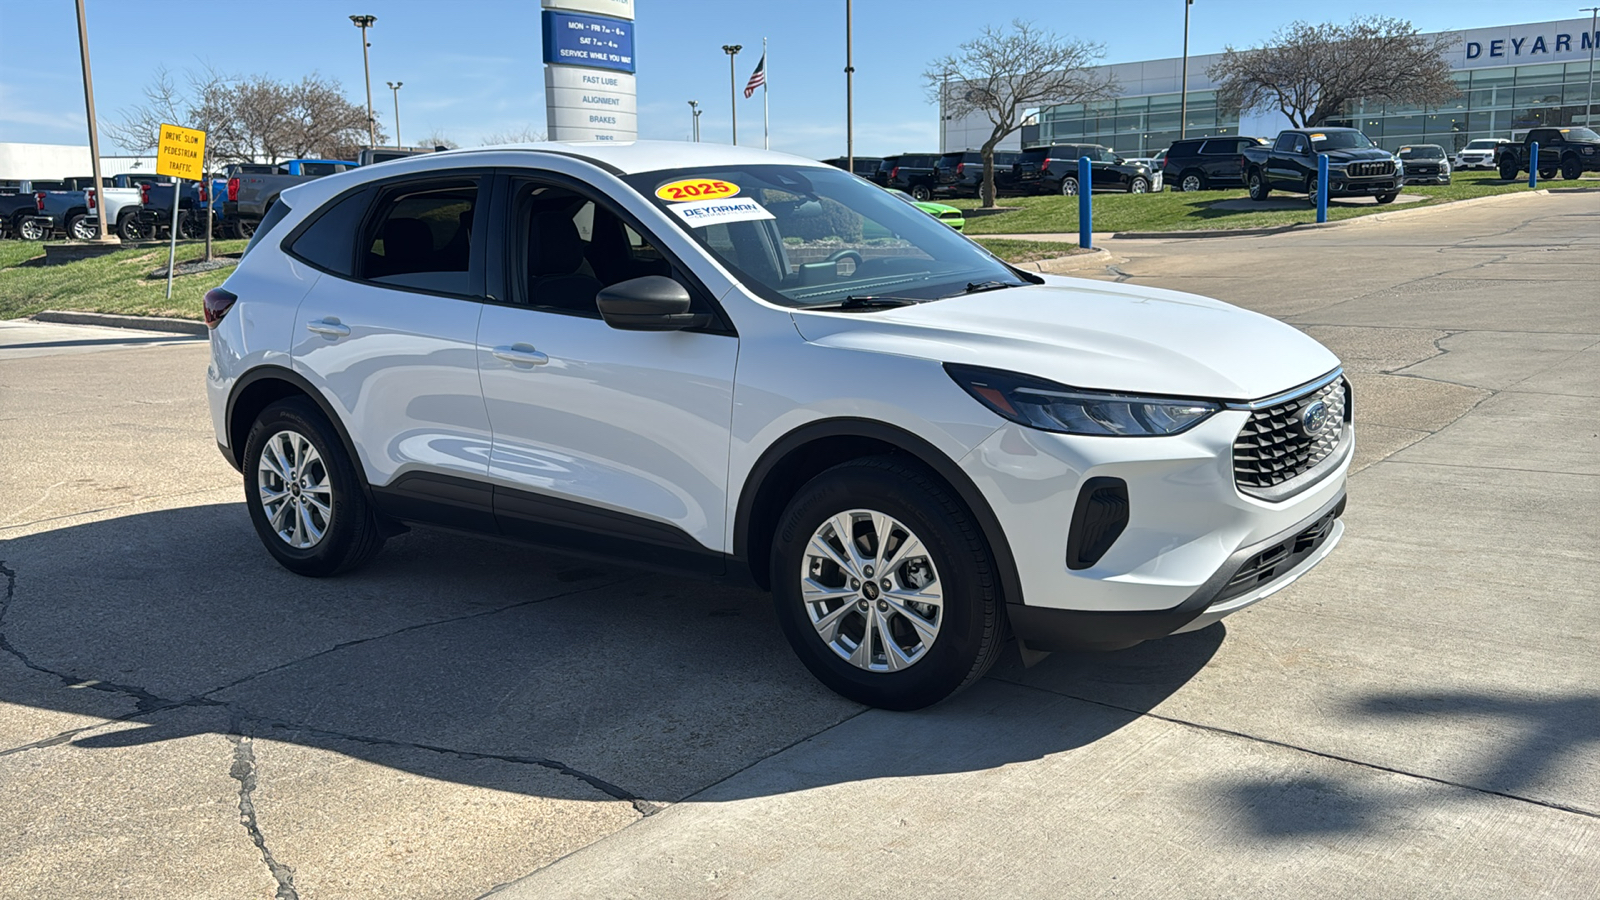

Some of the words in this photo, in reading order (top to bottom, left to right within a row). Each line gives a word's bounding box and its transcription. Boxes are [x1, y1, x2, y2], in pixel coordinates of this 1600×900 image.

[568, 21, 584, 30] MON
[591, 24, 601, 32] FRI
[579, 36, 591, 45] SAT
[560, 48, 588, 59] SERVICE
[589, 51, 608, 61] WHILE
[609, 54, 620, 63] YOU
[582, 75, 600, 84] FAST
[601, 77, 618, 87] LUBE
[582, 95, 620, 106] ALIGNMENT
[589, 115, 616, 125] BRAKES
[165, 131, 182, 142] DRIVE
[184, 134, 199, 144] SLOW
[163, 145, 198, 159] PEDESTRIAN
[169, 161, 192, 173] TRAFFIC
[667, 182, 731, 199] 2025
[683, 204, 758, 217] DEYARMAN
